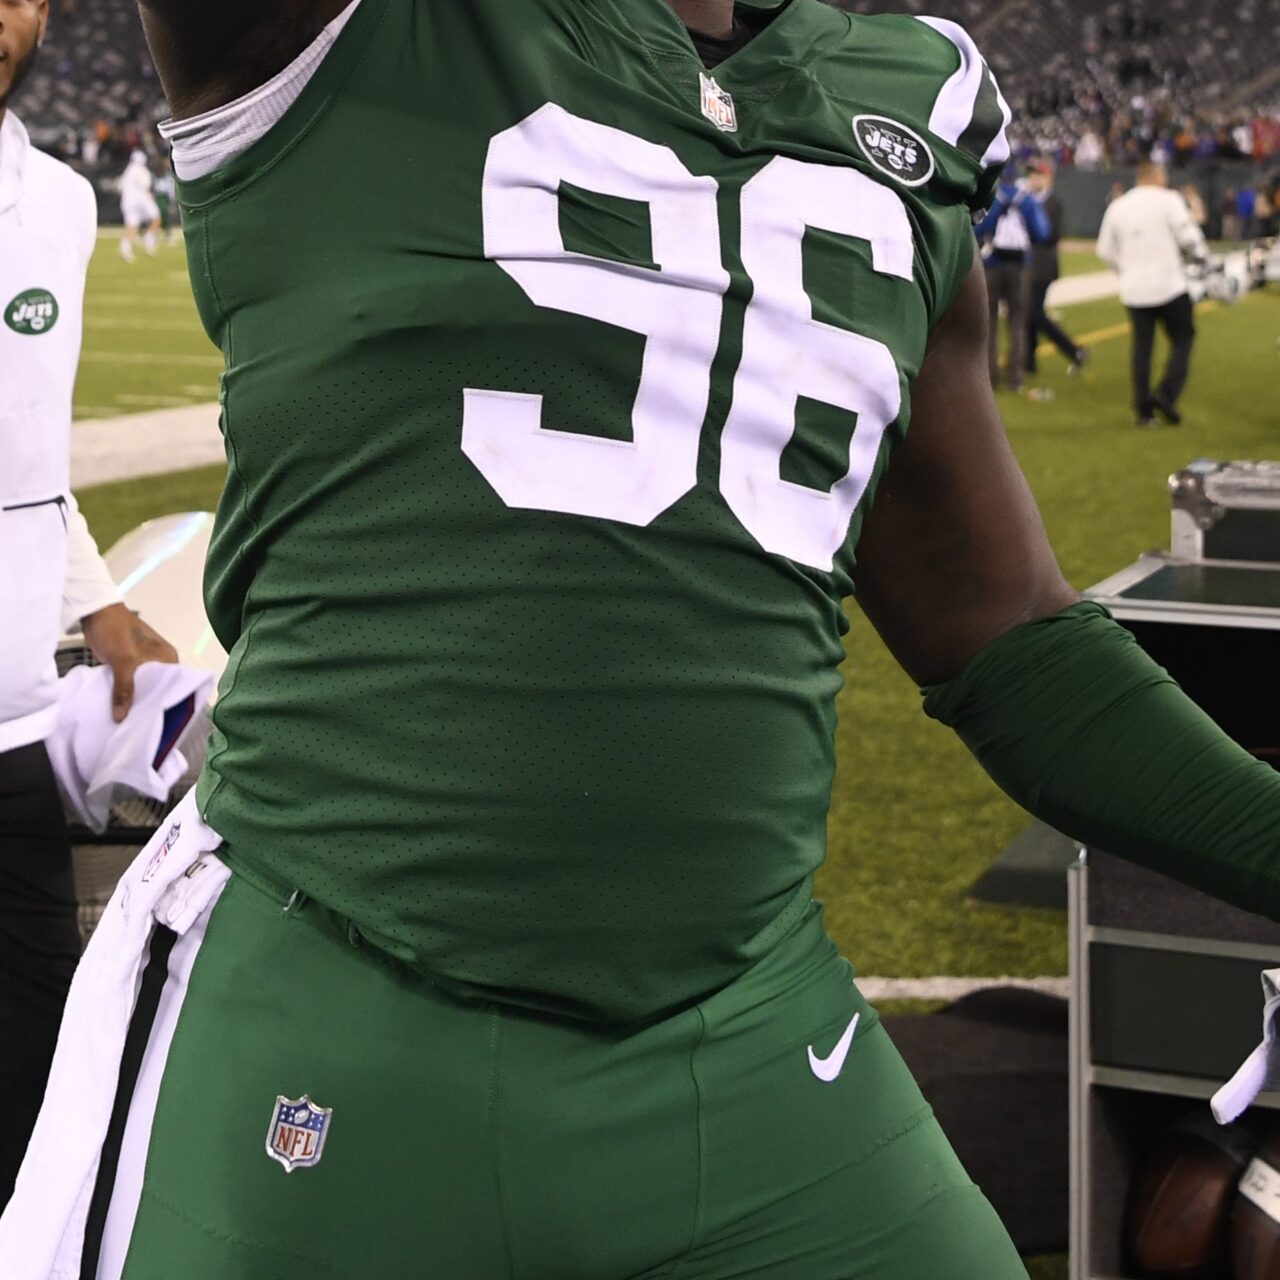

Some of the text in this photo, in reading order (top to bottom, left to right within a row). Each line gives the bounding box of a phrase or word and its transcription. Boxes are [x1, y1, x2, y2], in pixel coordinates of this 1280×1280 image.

[865, 130, 918, 164] JETS
[460, 101, 915, 573] 96
[276, 1125, 313, 1157] NFL
